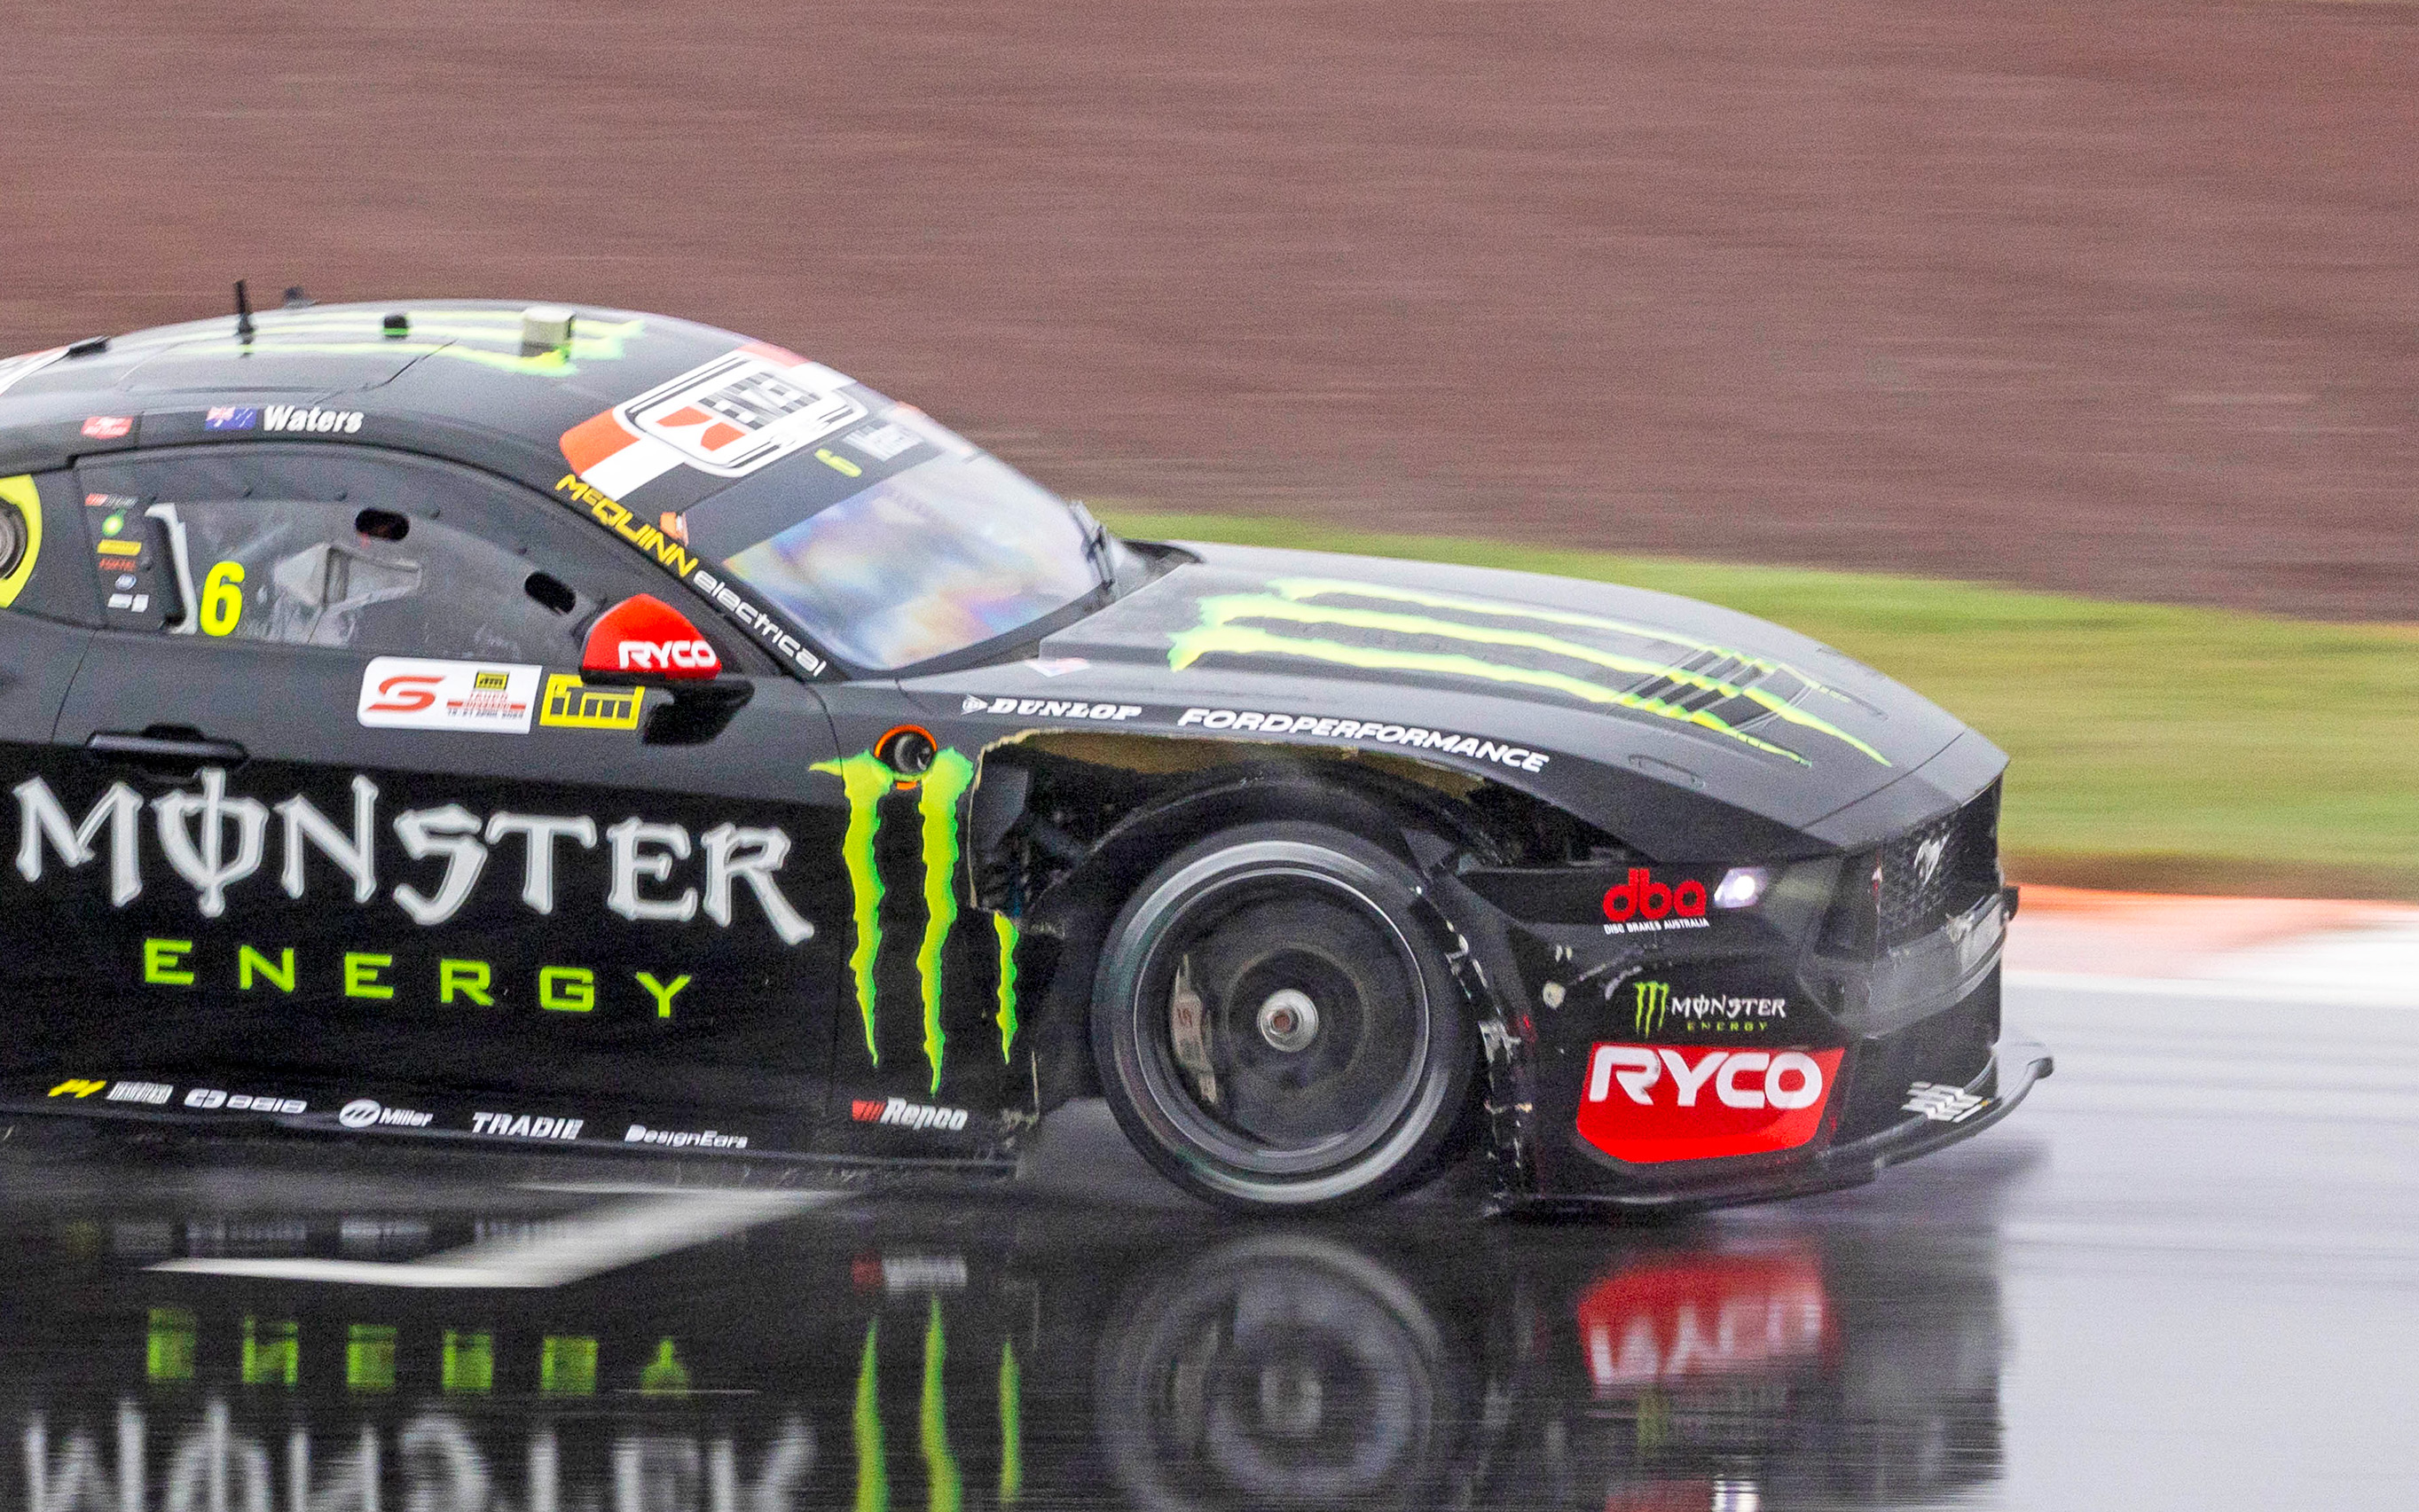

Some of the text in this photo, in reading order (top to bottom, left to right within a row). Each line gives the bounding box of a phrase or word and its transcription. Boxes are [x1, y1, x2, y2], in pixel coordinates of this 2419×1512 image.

[264, 405, 365, 434] Waters
[200, 560, 245, 637] 6
[693, 569, 827, 677] electrical
[617, 640, 717, 669] RYCO
[986, 697, 1143, 721] DUNLOP
[13, 768, 815, 946] MONSTER
[1603, 867, 1707, 922] dba
[1663, 917, 1710, 930] AUSTRALIA
[144, 938, 691, 1018] ENERGY
[1670, 993, 1787, 1020] MONSTER
[1589, 1045, 1823, 1109] RYCO
[379, 1108, 433, 1127] Miller
